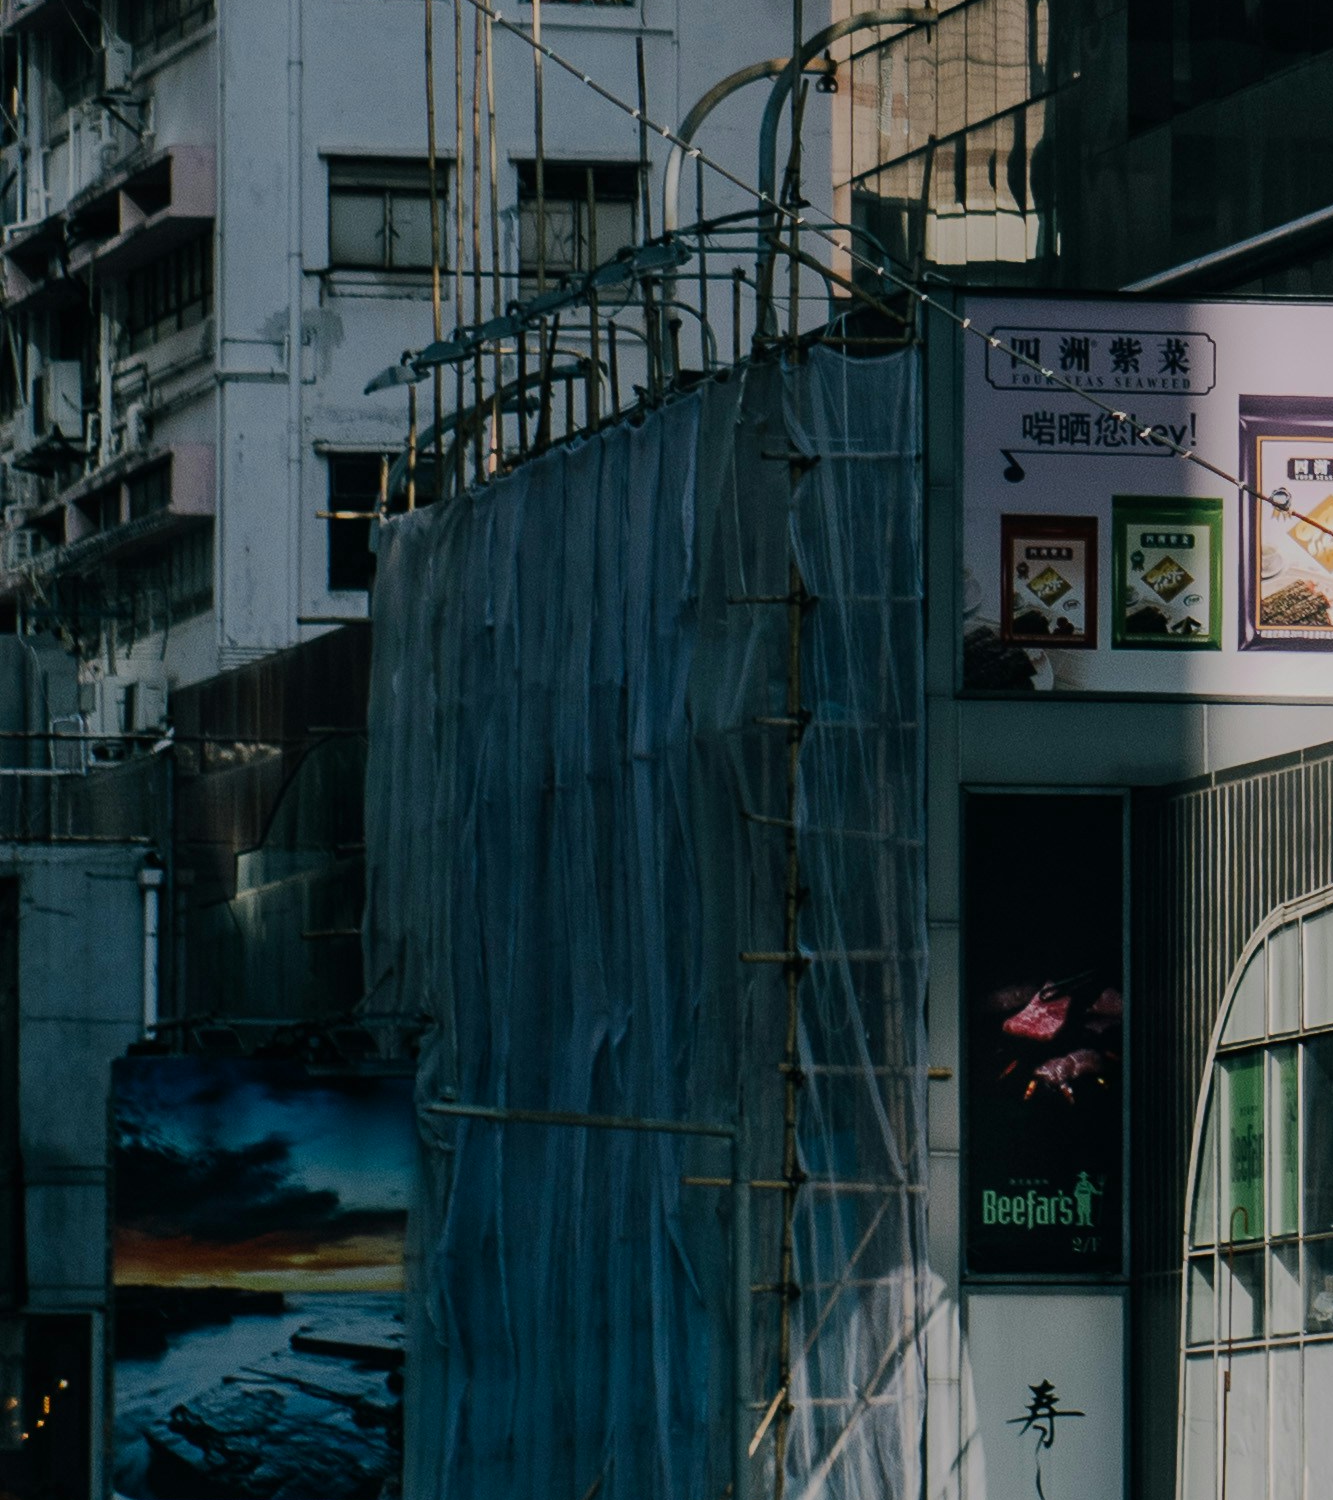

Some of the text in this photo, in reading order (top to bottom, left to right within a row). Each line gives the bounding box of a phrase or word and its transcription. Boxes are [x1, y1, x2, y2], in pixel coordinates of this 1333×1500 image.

[1010, 337, 1190, 374] 四洲紫菜
[1012, 373, 1055, 385] FOUR
[1114, 377, 1191, 389] SEAWEED
[983, 1189, 1073, 1230] Beefar's
